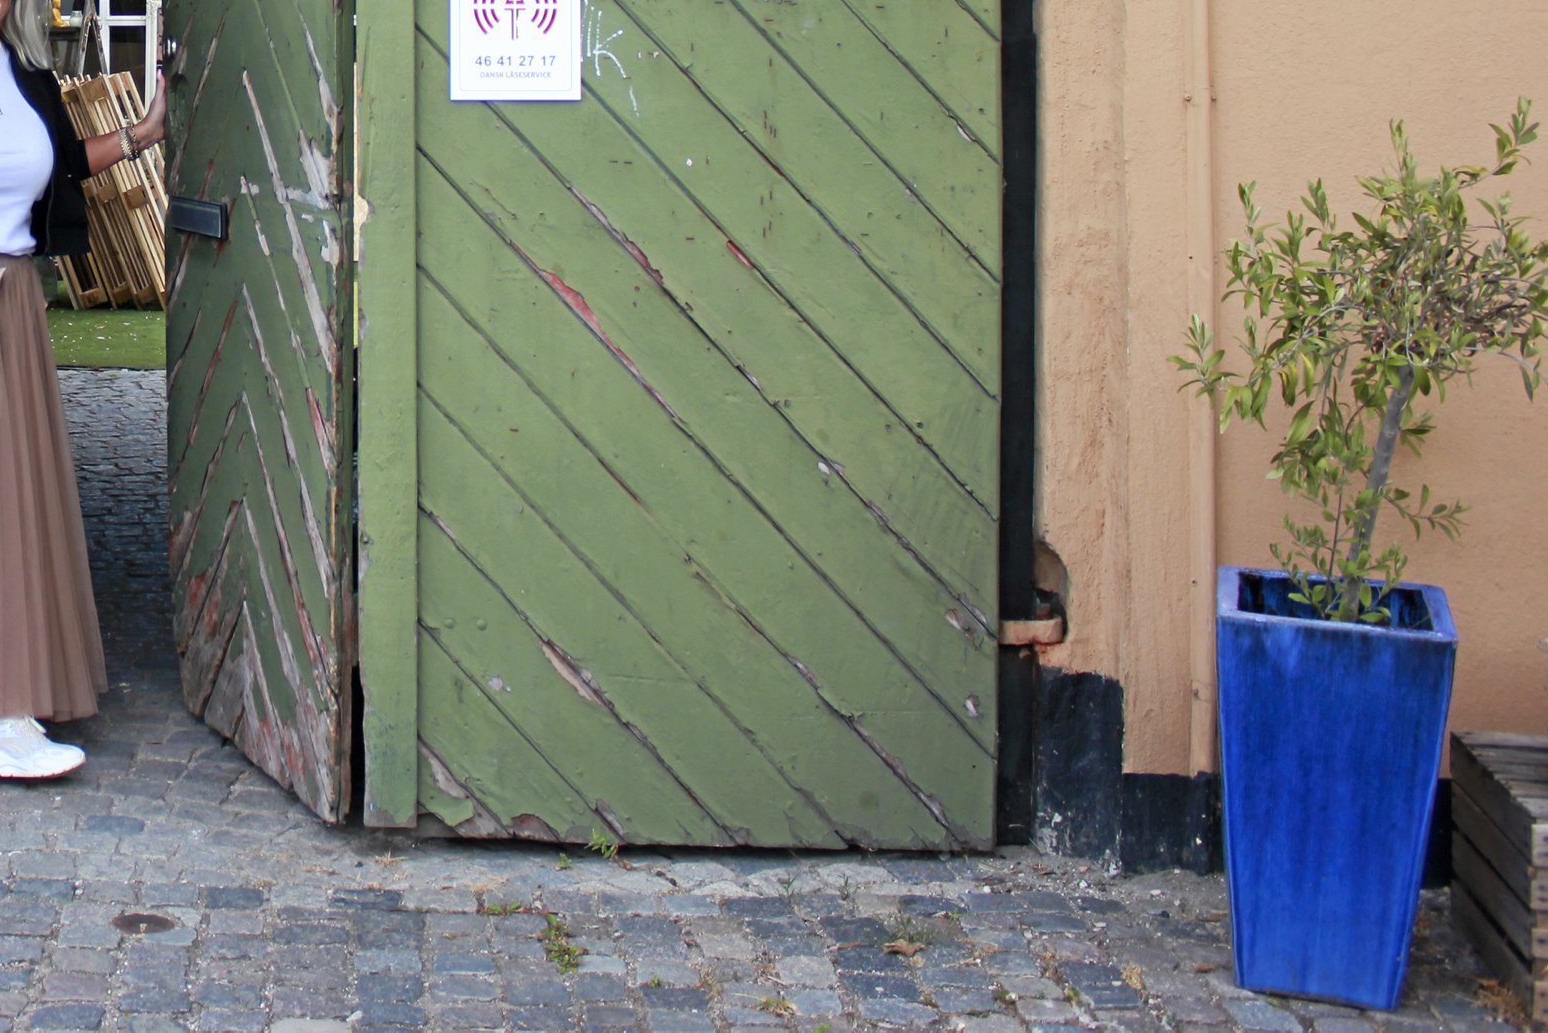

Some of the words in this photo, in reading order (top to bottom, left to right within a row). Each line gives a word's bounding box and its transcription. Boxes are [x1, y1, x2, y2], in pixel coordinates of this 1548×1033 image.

[475, 55, 492, 67] 46
[497, 55, 512, 67] 41
[518, 55, 535, 67] 27
[540, 55, 556, 67] 17
[480, 71, 504, 79] DANSK
[505, 70, 552, 79] LÅSESERVICE
